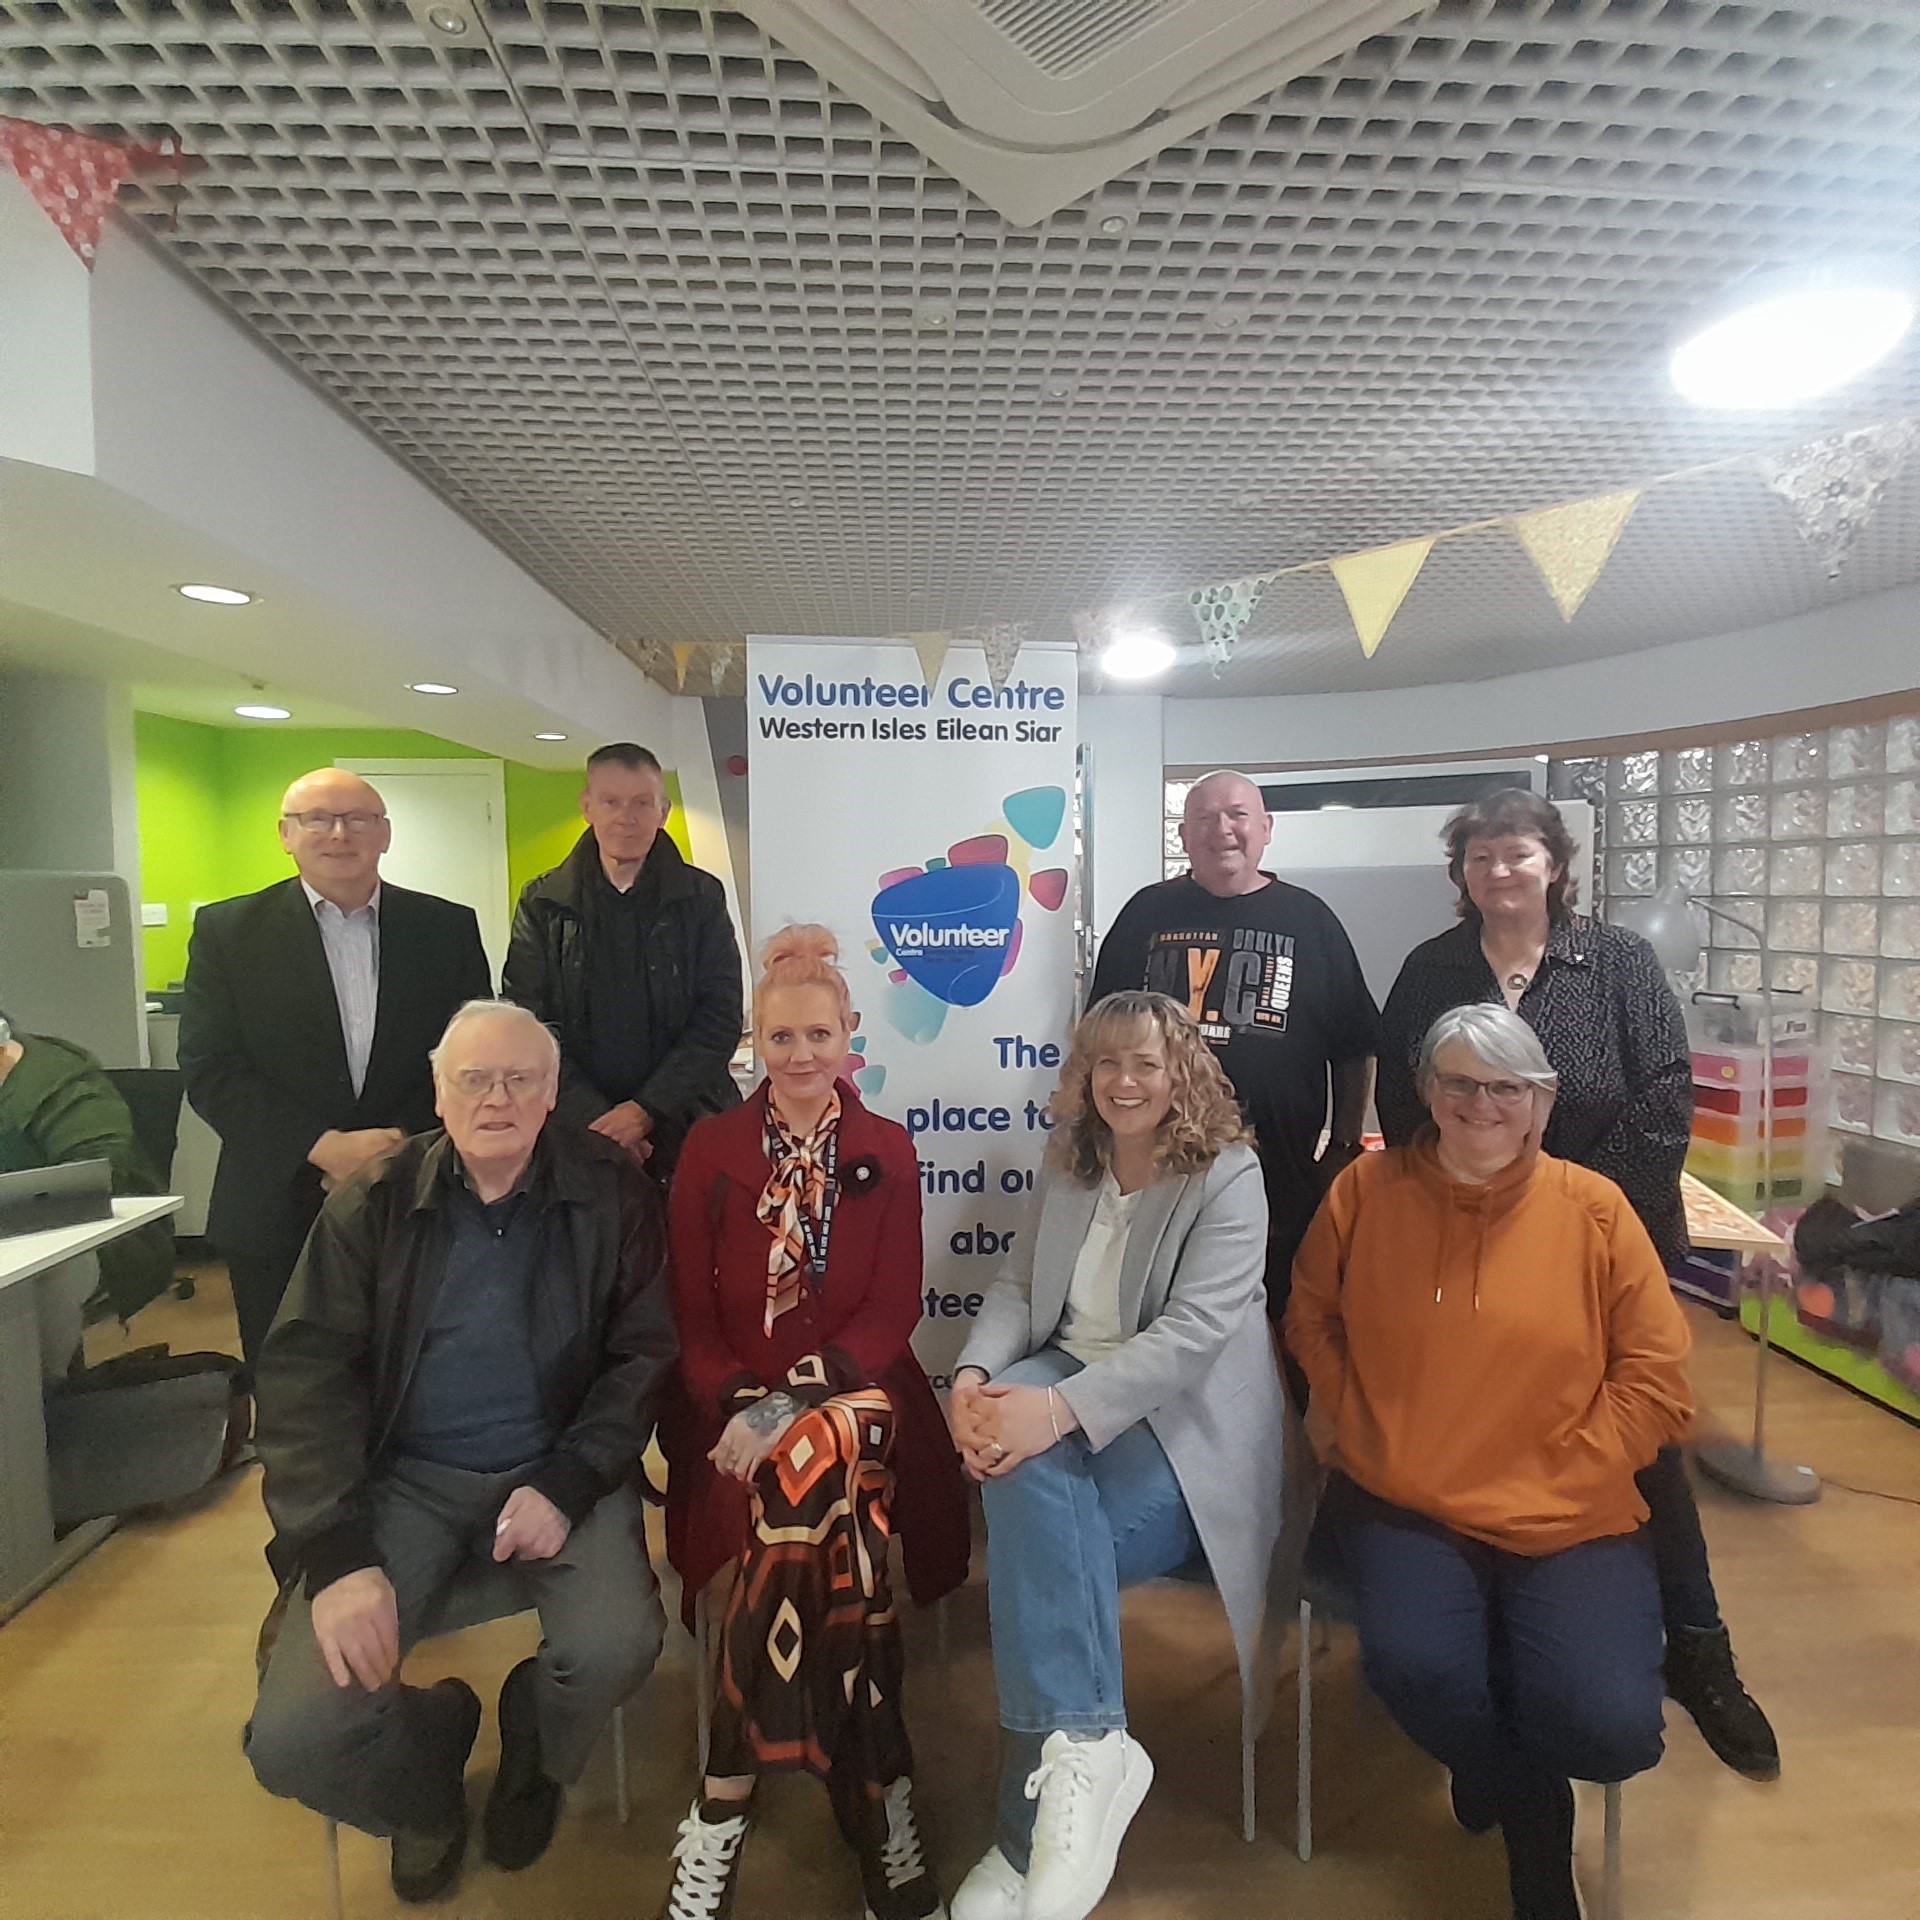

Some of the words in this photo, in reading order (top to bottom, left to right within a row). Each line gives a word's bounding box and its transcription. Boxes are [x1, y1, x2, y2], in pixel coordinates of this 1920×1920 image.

[948, 677, 1065, 710] Centre
[759, 716, 865, 740] Western
[872, 717, 926, 741] Isles
[937, 717, 1008, 742] Eilean
[1015, 719, 1062, 743] Siar
[890, 921, 1010, 948] Volunteer
[1270, 955, 1294, 1011] QUEENS
[994, 1035, 1060, 1068] The
[907, 1099, 1011, 1138] place
